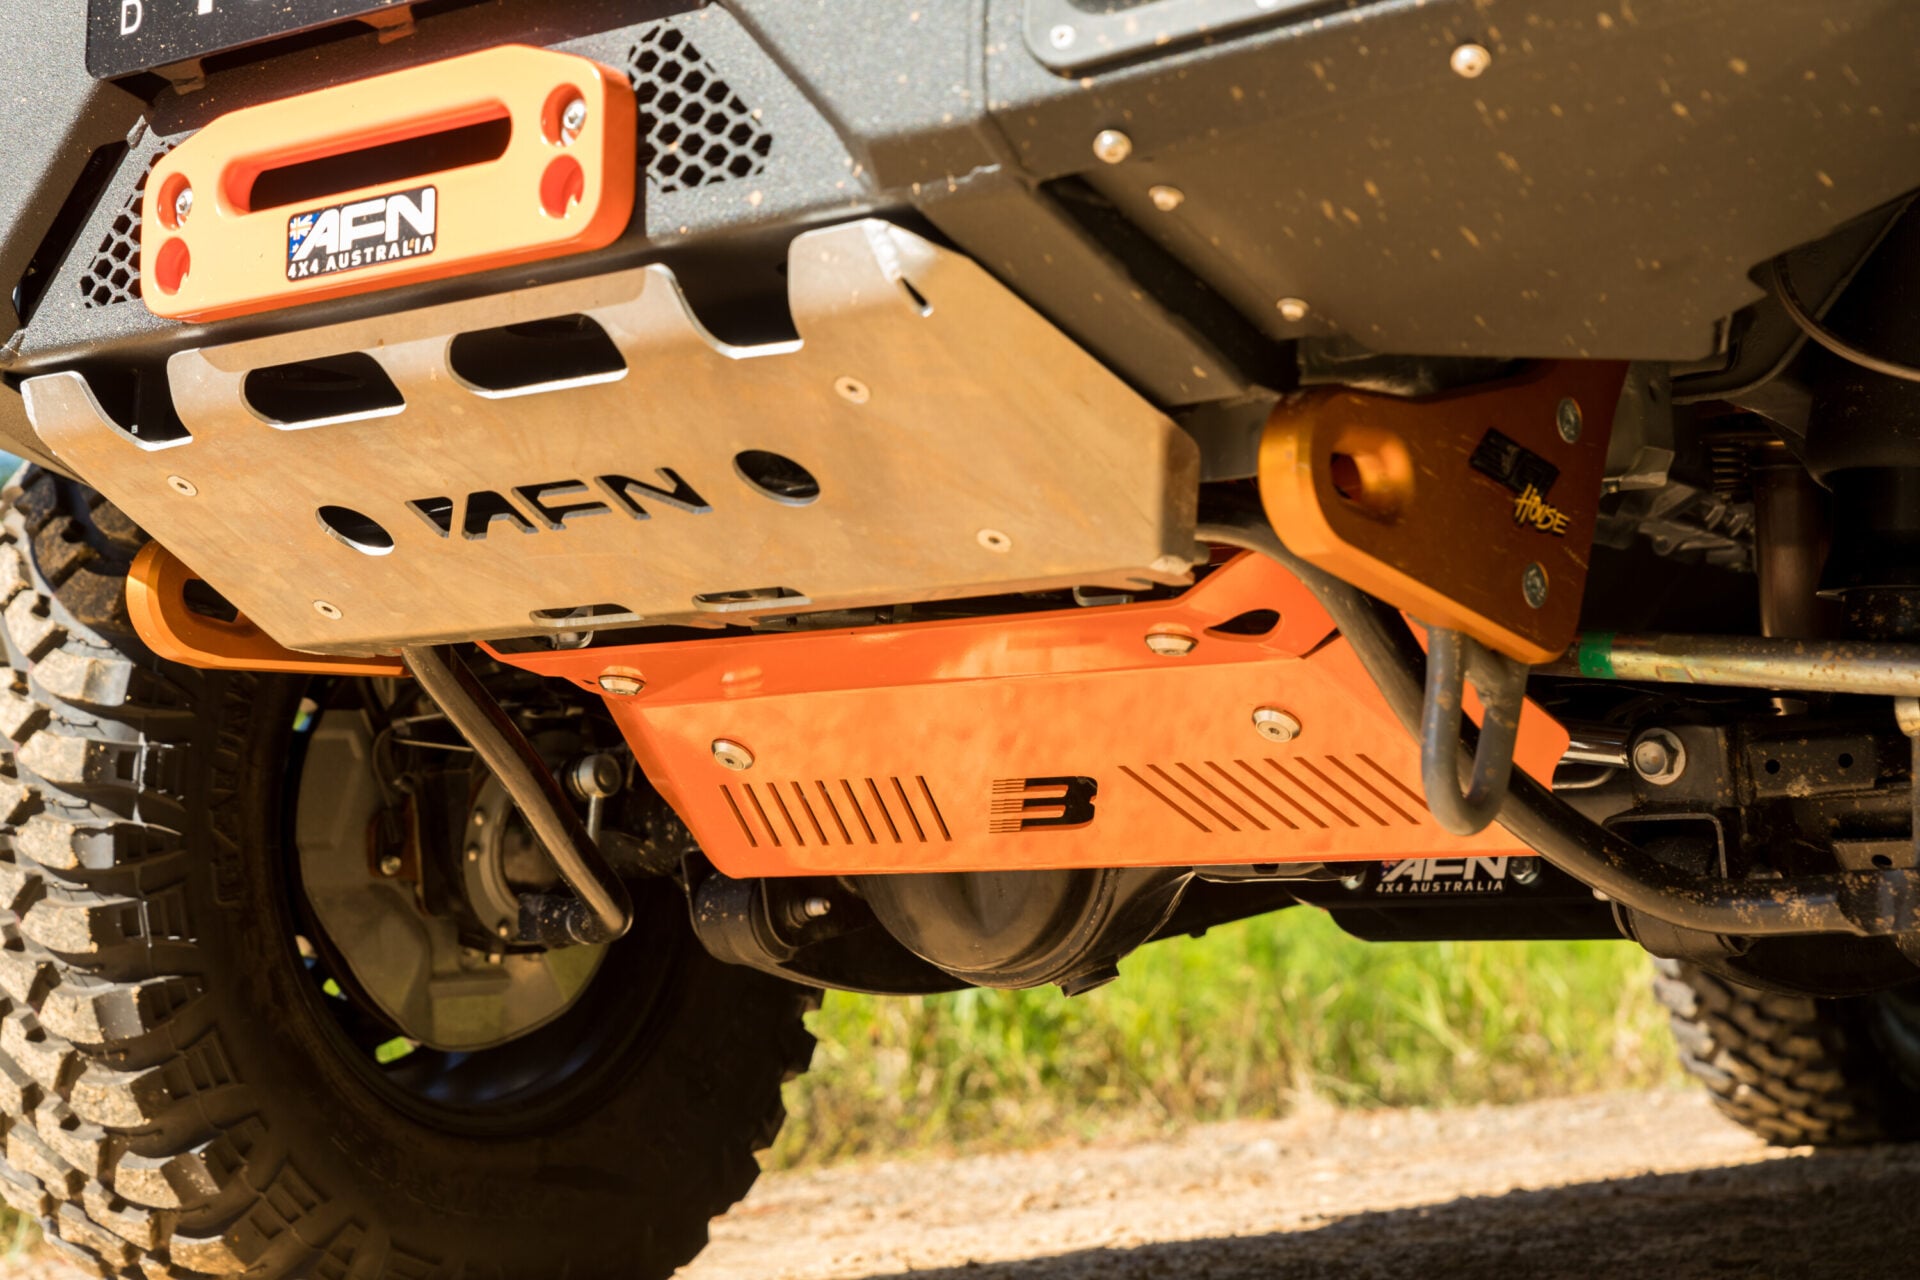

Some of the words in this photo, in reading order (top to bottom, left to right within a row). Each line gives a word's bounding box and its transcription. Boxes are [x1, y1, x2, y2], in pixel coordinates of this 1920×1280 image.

[291, 187, 436, 262] AFN
[287, 259, 319, 279] 4X4
[325, 235, 434, 272] AUSTRALIA
[459, 467, 713, 541] AFN
[1514, 483, 1570, 534] HOUSE
[1376, 882, 1403, 894] 4X4
[1409, 880, 1504, 893] AUSTRALIA
[1381, 856, 1509, 882] AFN
